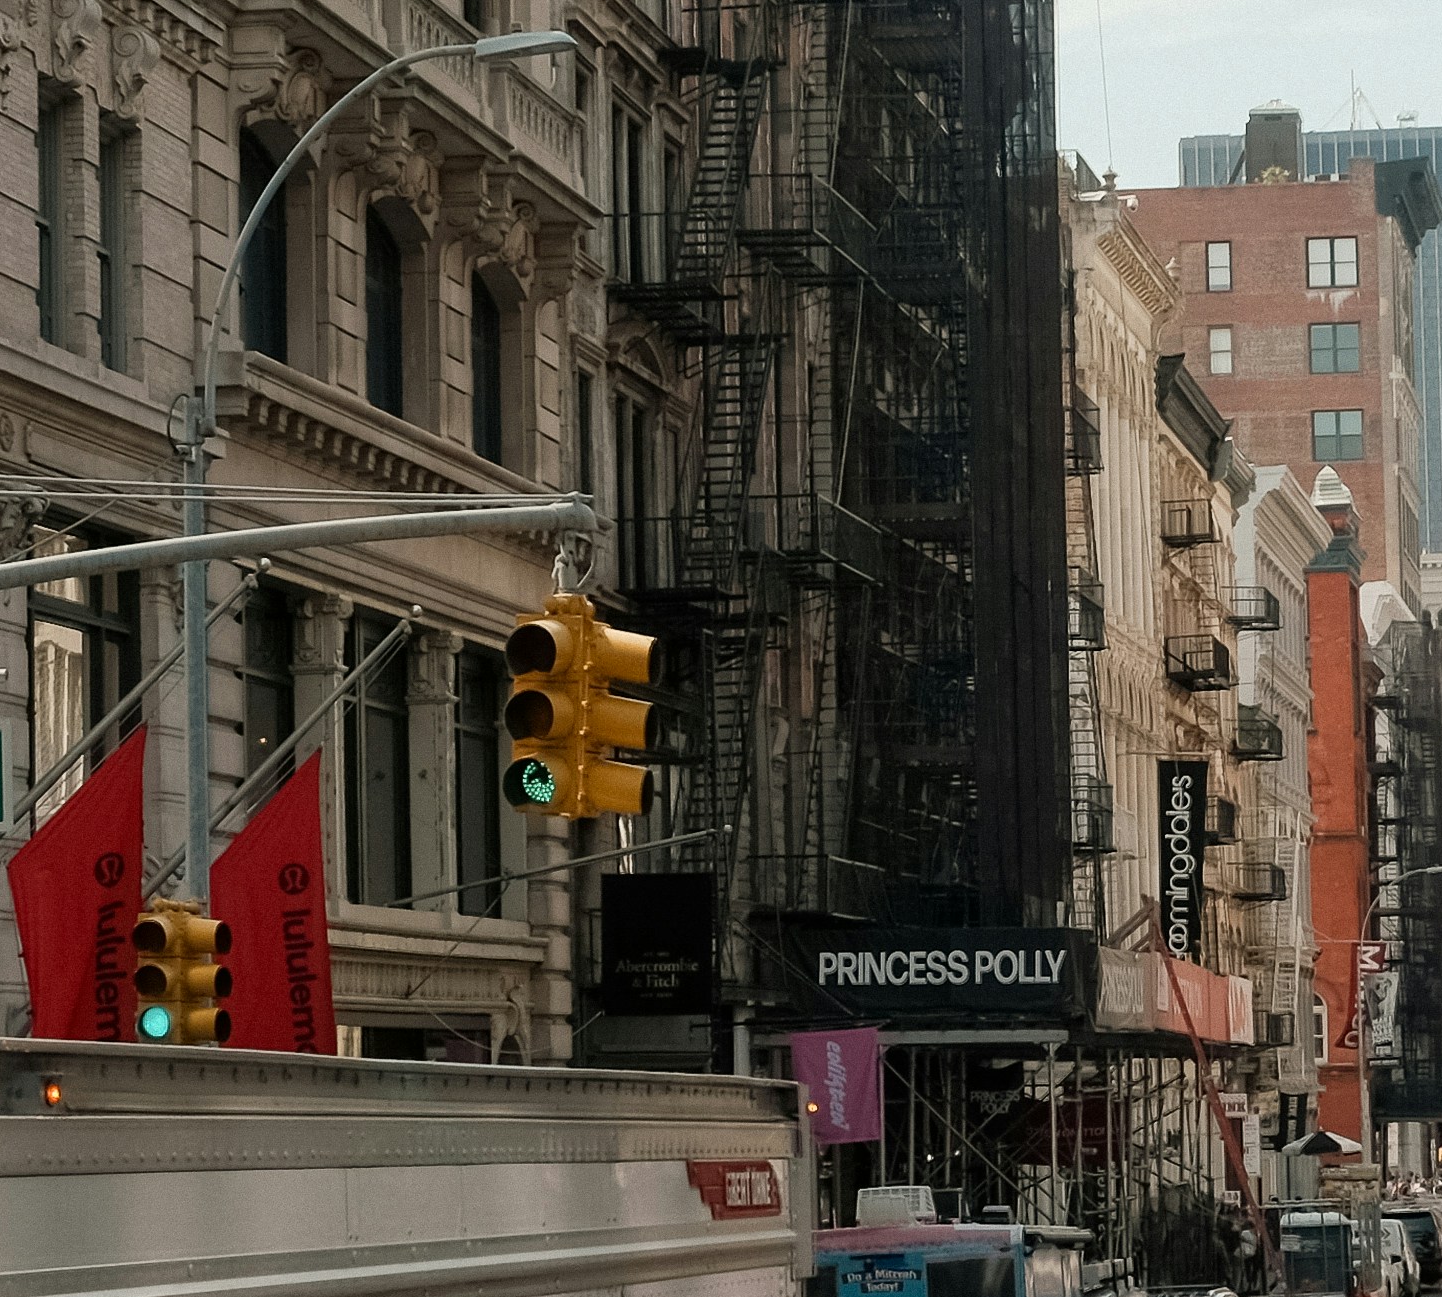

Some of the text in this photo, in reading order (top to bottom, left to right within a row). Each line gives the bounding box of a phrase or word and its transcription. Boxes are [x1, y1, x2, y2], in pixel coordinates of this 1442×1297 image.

[1164, 773, 1196, 959] oomingdale's
[280, 908, 319, 1054] lululem
[615, 958, 699, 973] Abercrombie
[646, 974, 681, 988] Fitch
[818, 949, 1068, 986] PRINCESS POLLY
